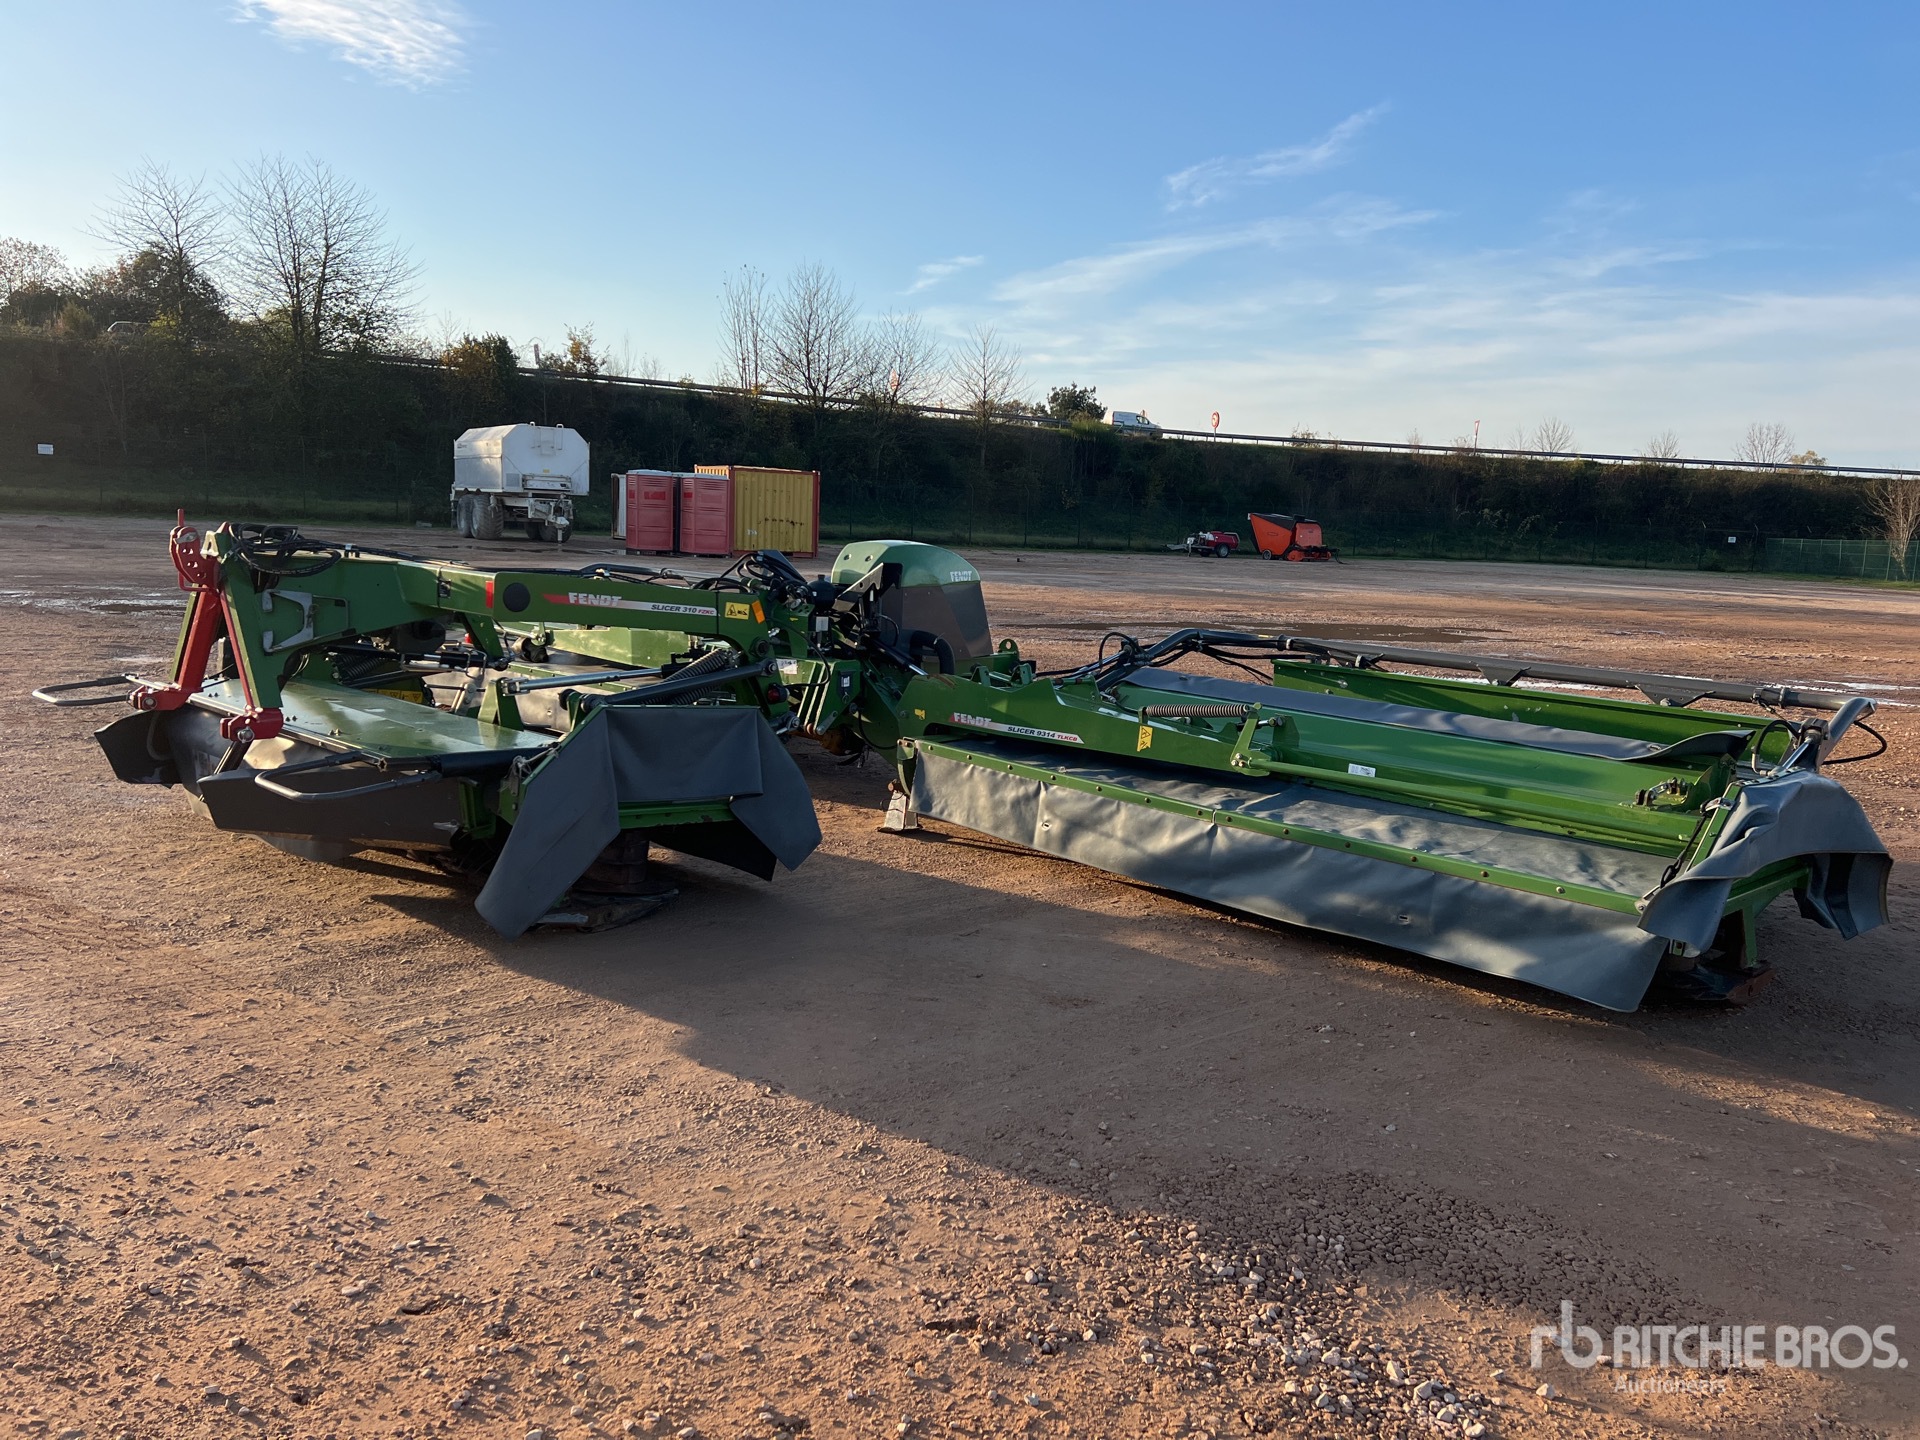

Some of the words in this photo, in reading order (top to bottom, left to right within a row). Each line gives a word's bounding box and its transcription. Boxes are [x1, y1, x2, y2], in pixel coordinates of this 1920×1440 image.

[950, 570, 972, 582] FENDT
[568, 592, 622, 607] FENDT
[651, 604, 681, 612] SLICER
[953, 712, 992, 728] FENDT
[1007, 726, 1036, 736] SLICER
[1036, 730, 1056, 738] 9314
